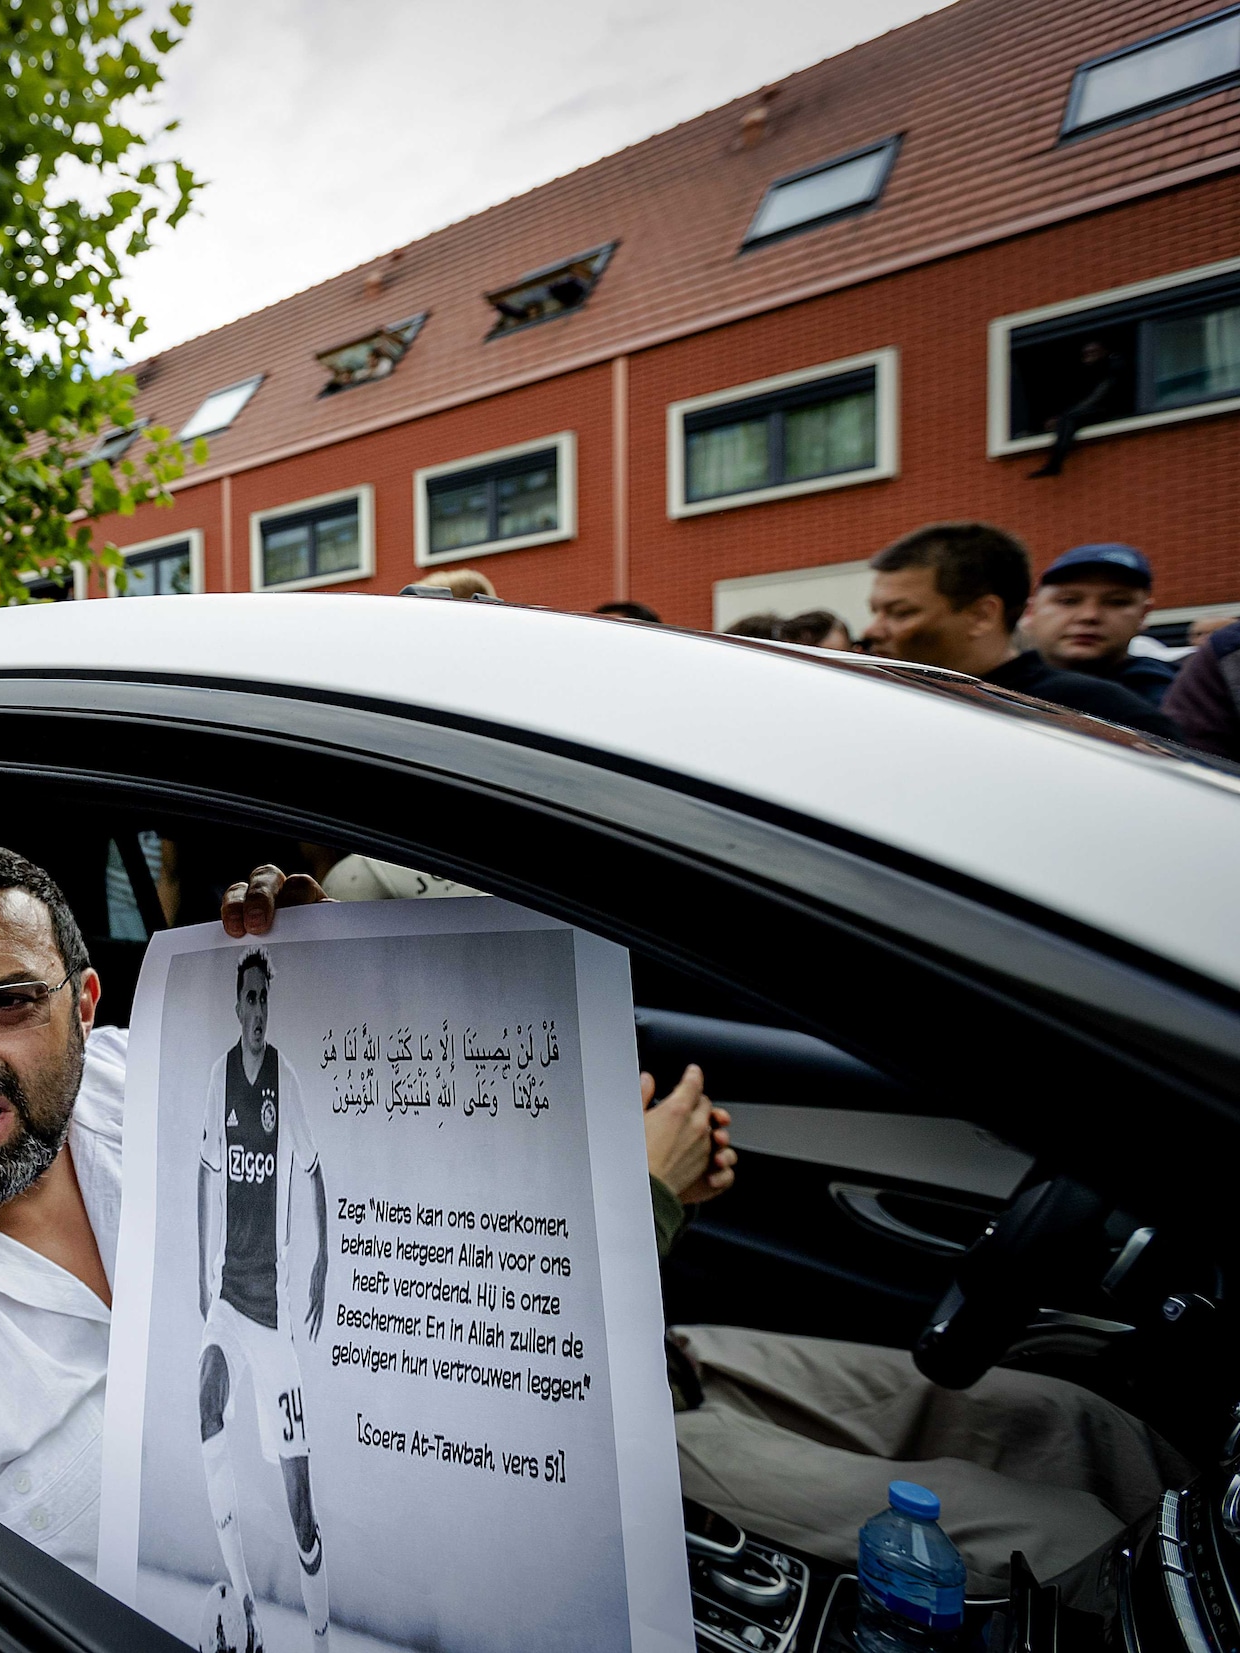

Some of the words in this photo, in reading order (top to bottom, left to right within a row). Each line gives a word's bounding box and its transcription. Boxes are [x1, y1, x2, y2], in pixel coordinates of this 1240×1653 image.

[416, 1202, 443, 1227] kan
[447, 1211, 475, 1229] ons
[480, 1209, 569, 1239] overkomen,
[341, 1233, 392, 1259] behalve
[396, 1236, 454, 1267] hetgeen
[458, 1243, 493, 1270] Allah
[498, 1251, 536, 1273] voor
[540, 1256, 571, 1277] ons
[352, 1268, 389, 1295] heeft
[393, 1277, 472, 1305] verordend.
[477, 1281, 497, 1312] Hij
[501, 1285, 516, 1310] is
[520, 1293, 561, 1315] onze
[336, 1303, 421, 1337] Beschermer.
[426, 1315, 445, 1340] En
[449, 1318, 463, 1343] in
[468, 1319, 504, 1349] Allah
[510, 1327, 556, 1356] zullen
[561, 1331, 584, 1359] de
[332, 1341, 397, 1373] gelovigen
[401, 1349, 428, 1377] hun
[432, 1358, 521, 1391] vertrouwen
[278, 1386, 306, 1442] 34
[357, 1413, 406, 1453] [Soera
[411, 1430, 496, 1472] At-Tawbah,
[502, 1451, 539, 1478] vers
[544, 1449, 566, 1483] 51]
